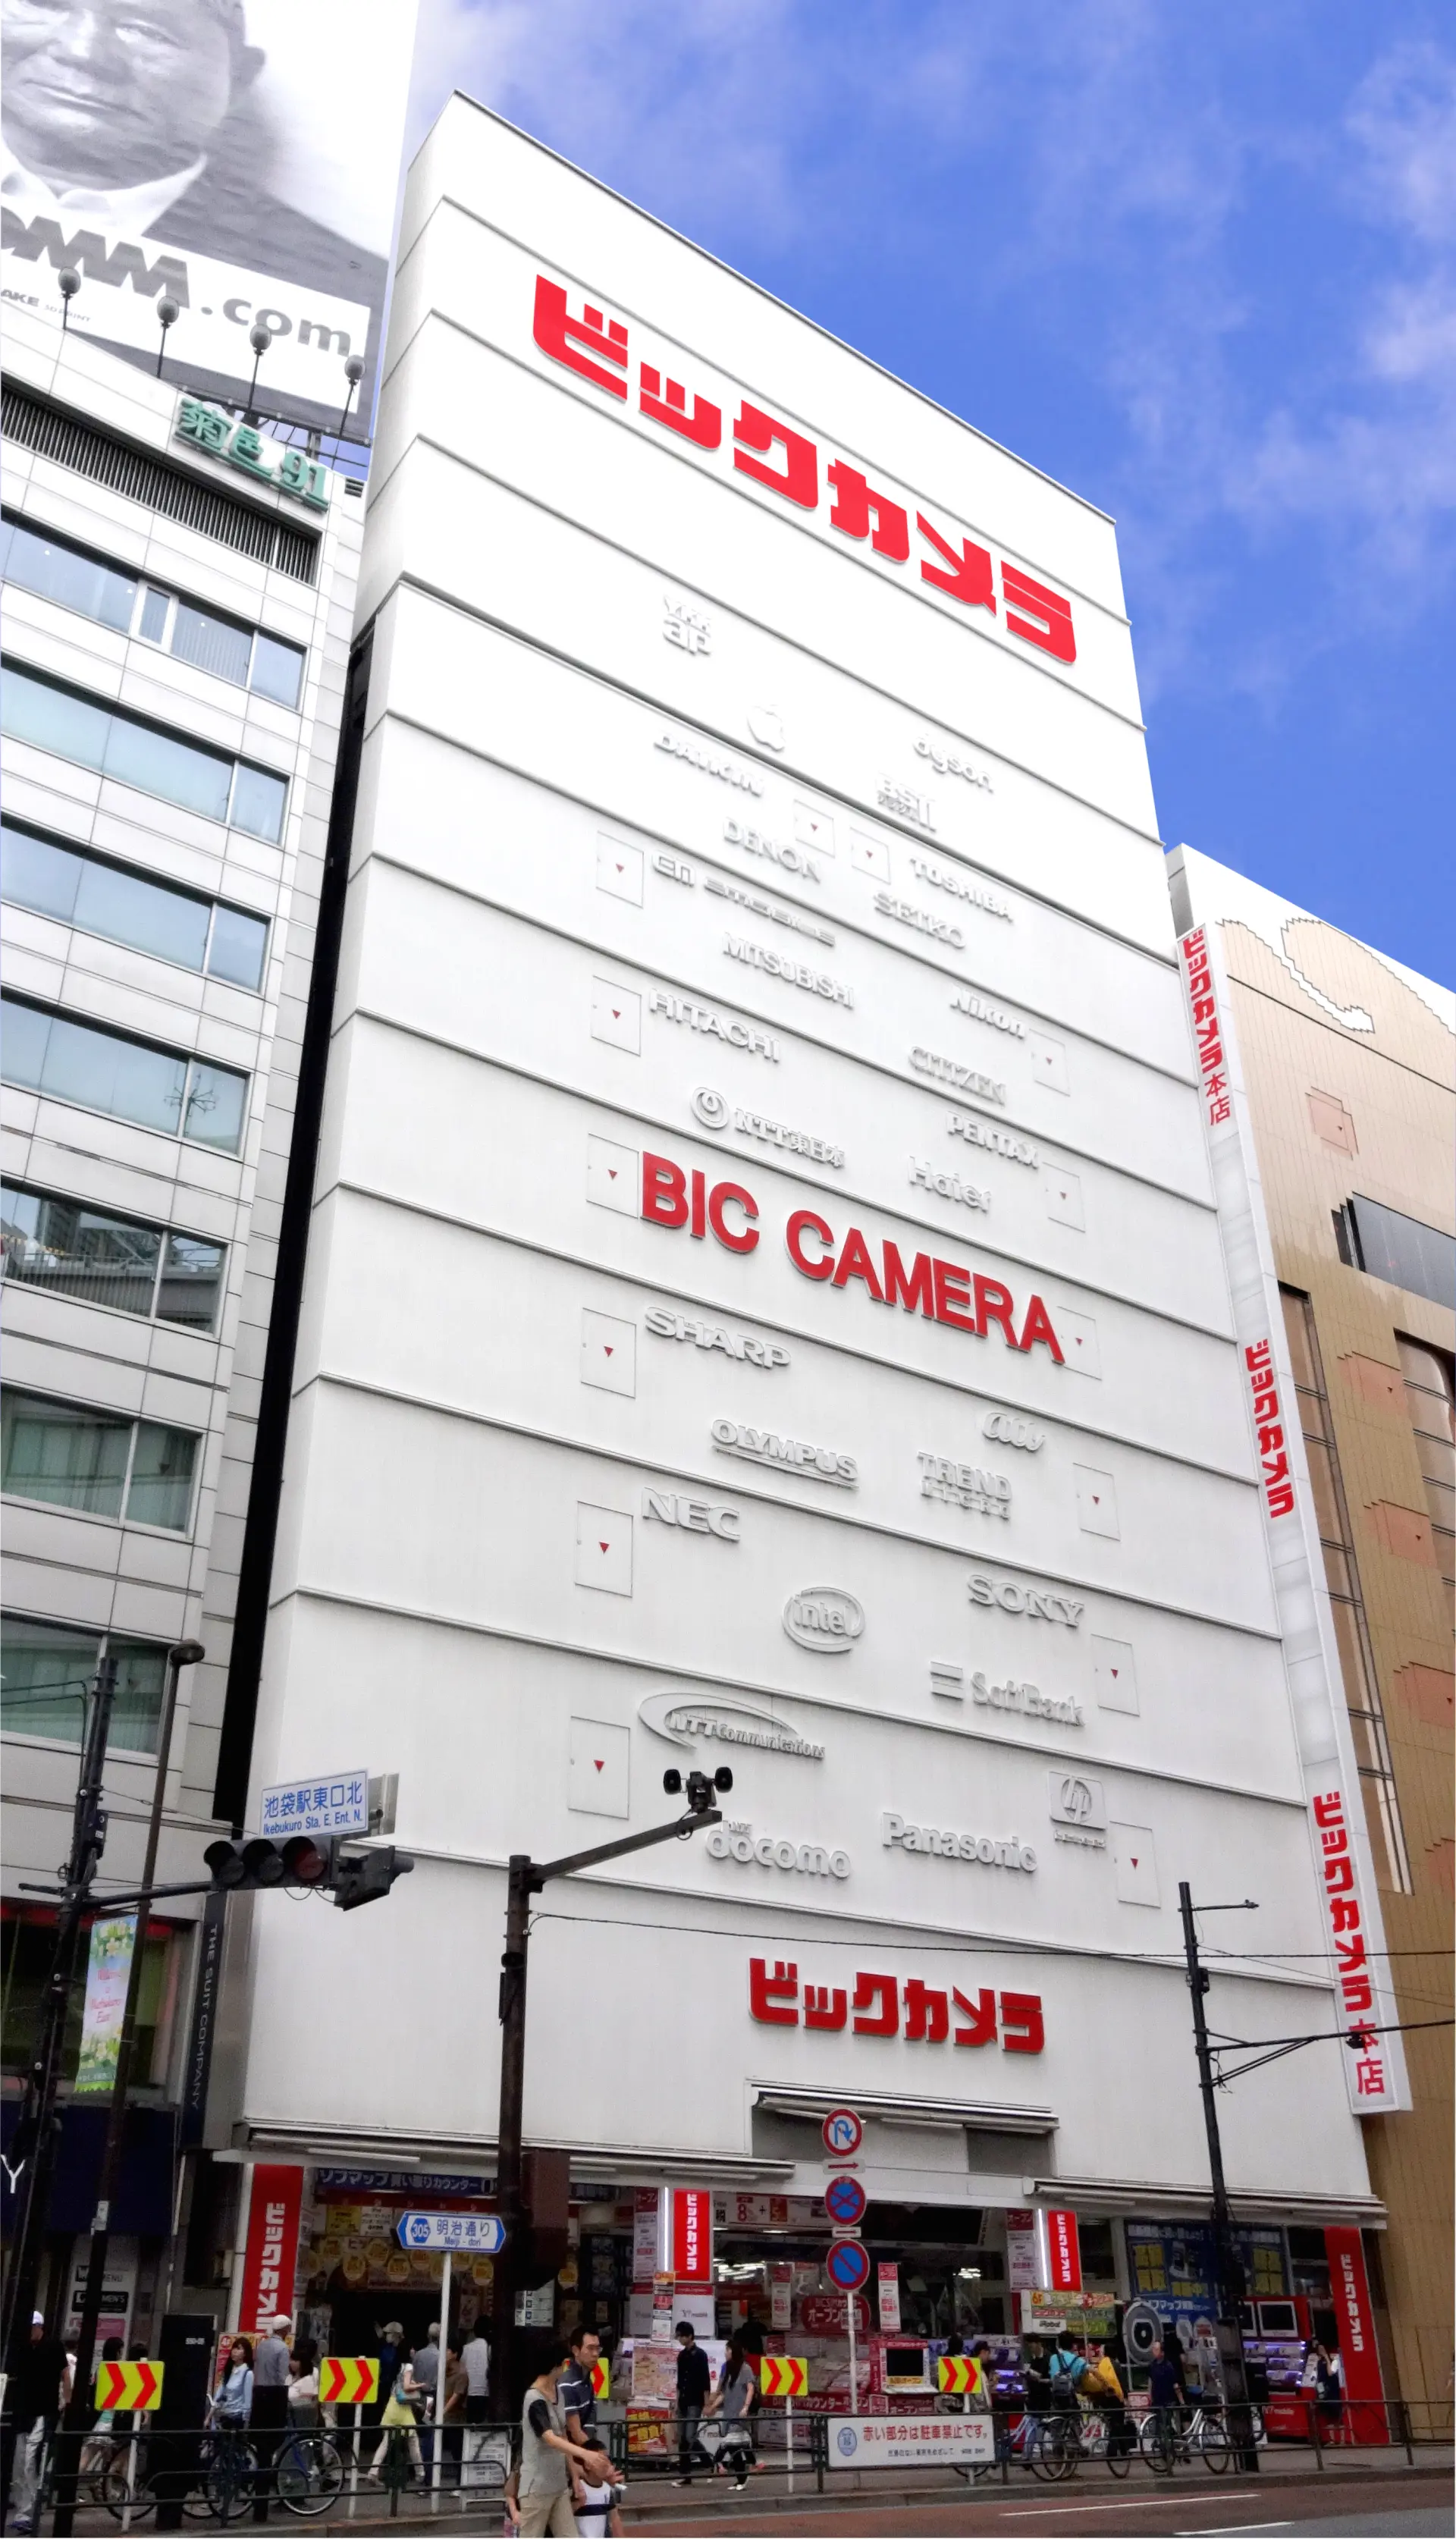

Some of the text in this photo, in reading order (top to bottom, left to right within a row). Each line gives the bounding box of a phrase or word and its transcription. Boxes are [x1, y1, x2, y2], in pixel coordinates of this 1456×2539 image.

[533, 274, 1077, 664] ビックカメラ
[654, 730, 763, 797] DAIKIN
[912, 733, 994, 793] dyson
[722, 817, 821, 883] DENON
[873, 889, 965, 949] SEIKO
[909, 856, 1015, 923] TOSHIBA
[722, 932, 855, 1009] MITSUBISHI
[648, 988, 780, 1062] HITACHI
[949, 985, 1027, 1039] Nikon
[1181, 927, 1232, 1126] ビックカメラ本店
[908, 1045, 1006, 1109] CITIZEN
[946, 1110, 1041, 1169] PENTAX
[640, 1150, 1065, 1365] BIC CAMERA
[644, 1306, 792, 1369] SHARP
[711, 1418, 859, 1483] OLYMPUS
[1244, 1338, 1295, 1519] ビックカメラ
[917, 1451, 1012, 1502] TREND
[642, 1486, 742, 1542] NEC
[968, 1574, 1084, 1628] SONY
[670, 1712, 717, 1737] NTT
[971, 1671, 1086, 1727] SoftBank
[263, 1809, 363, 1836] Ikebukuro Sta. E. Ent. N.
[264, 1781, 363, 1819] 池袋駅東口北
[705, 1820, 852, 1879] docomo
[881, 1812, 1037, 1874] Panasonic
[191, 1922, 218, 2111] THE SUIT COMPANY
[748, 1957, 1046, 2054] ビックカメラ
[412, 2219, 491, 2237] 305 明治通り
[863, 2424, 987, 2442] 赤い部分は駐車禁止です。
